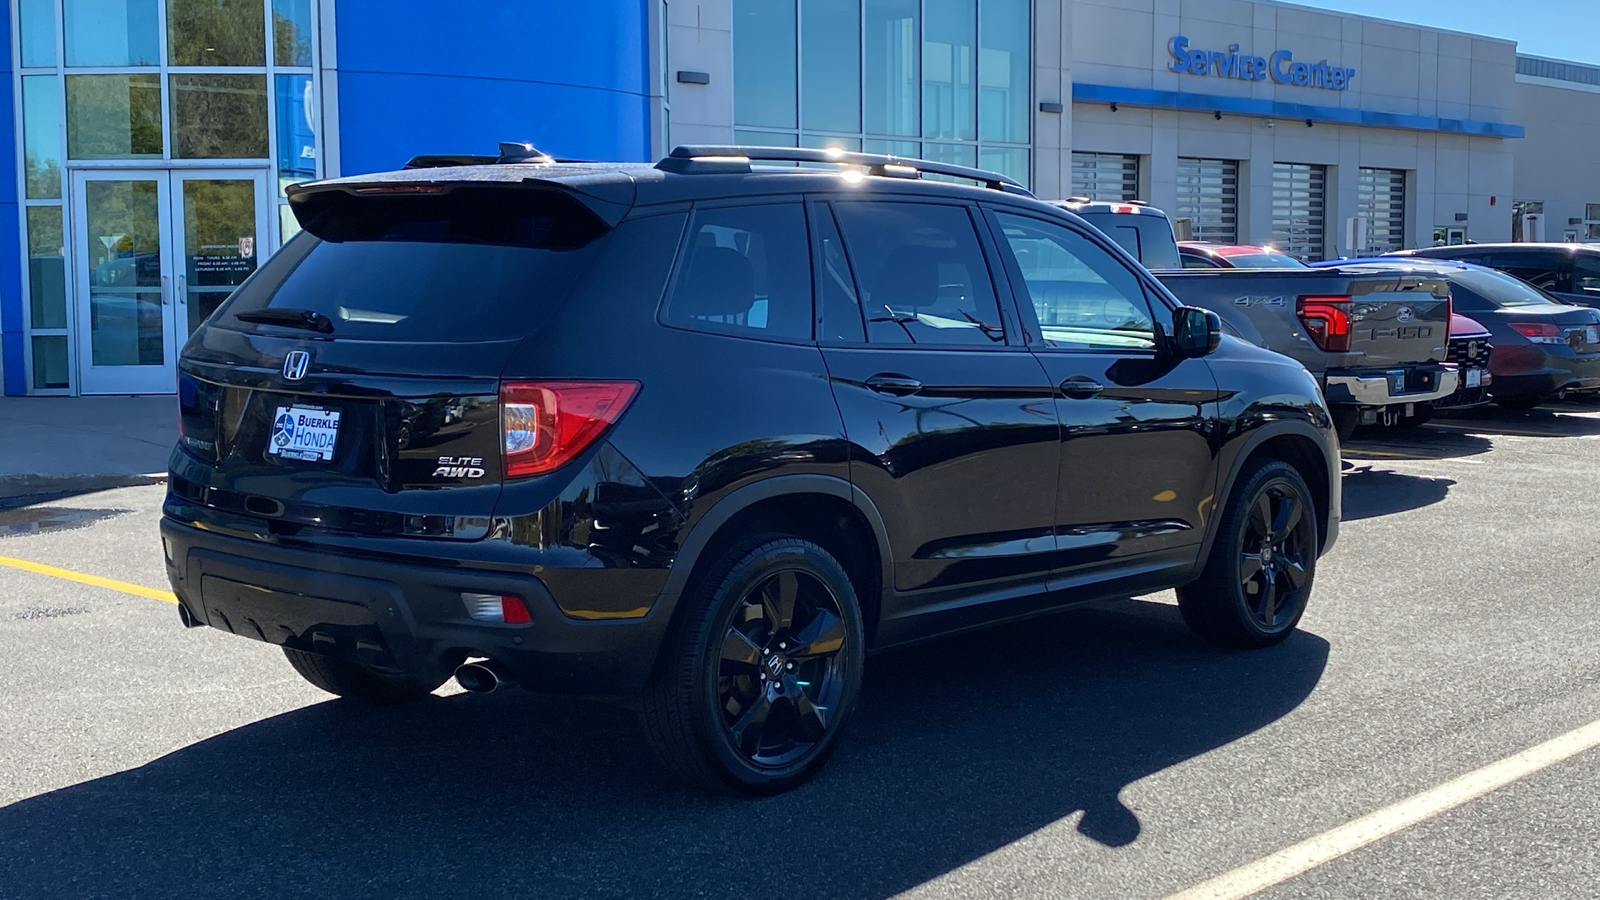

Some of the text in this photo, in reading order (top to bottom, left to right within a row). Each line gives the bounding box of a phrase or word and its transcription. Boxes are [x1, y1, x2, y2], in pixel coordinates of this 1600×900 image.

[1168, 35, 1356, 90] Service Center
[298, 415, 339, 429] BUERKLE
[294, 427, 334, 448] HONDA
[438, 456, 483, 465] ELITE
[432, 466, 485, 478] AWD
